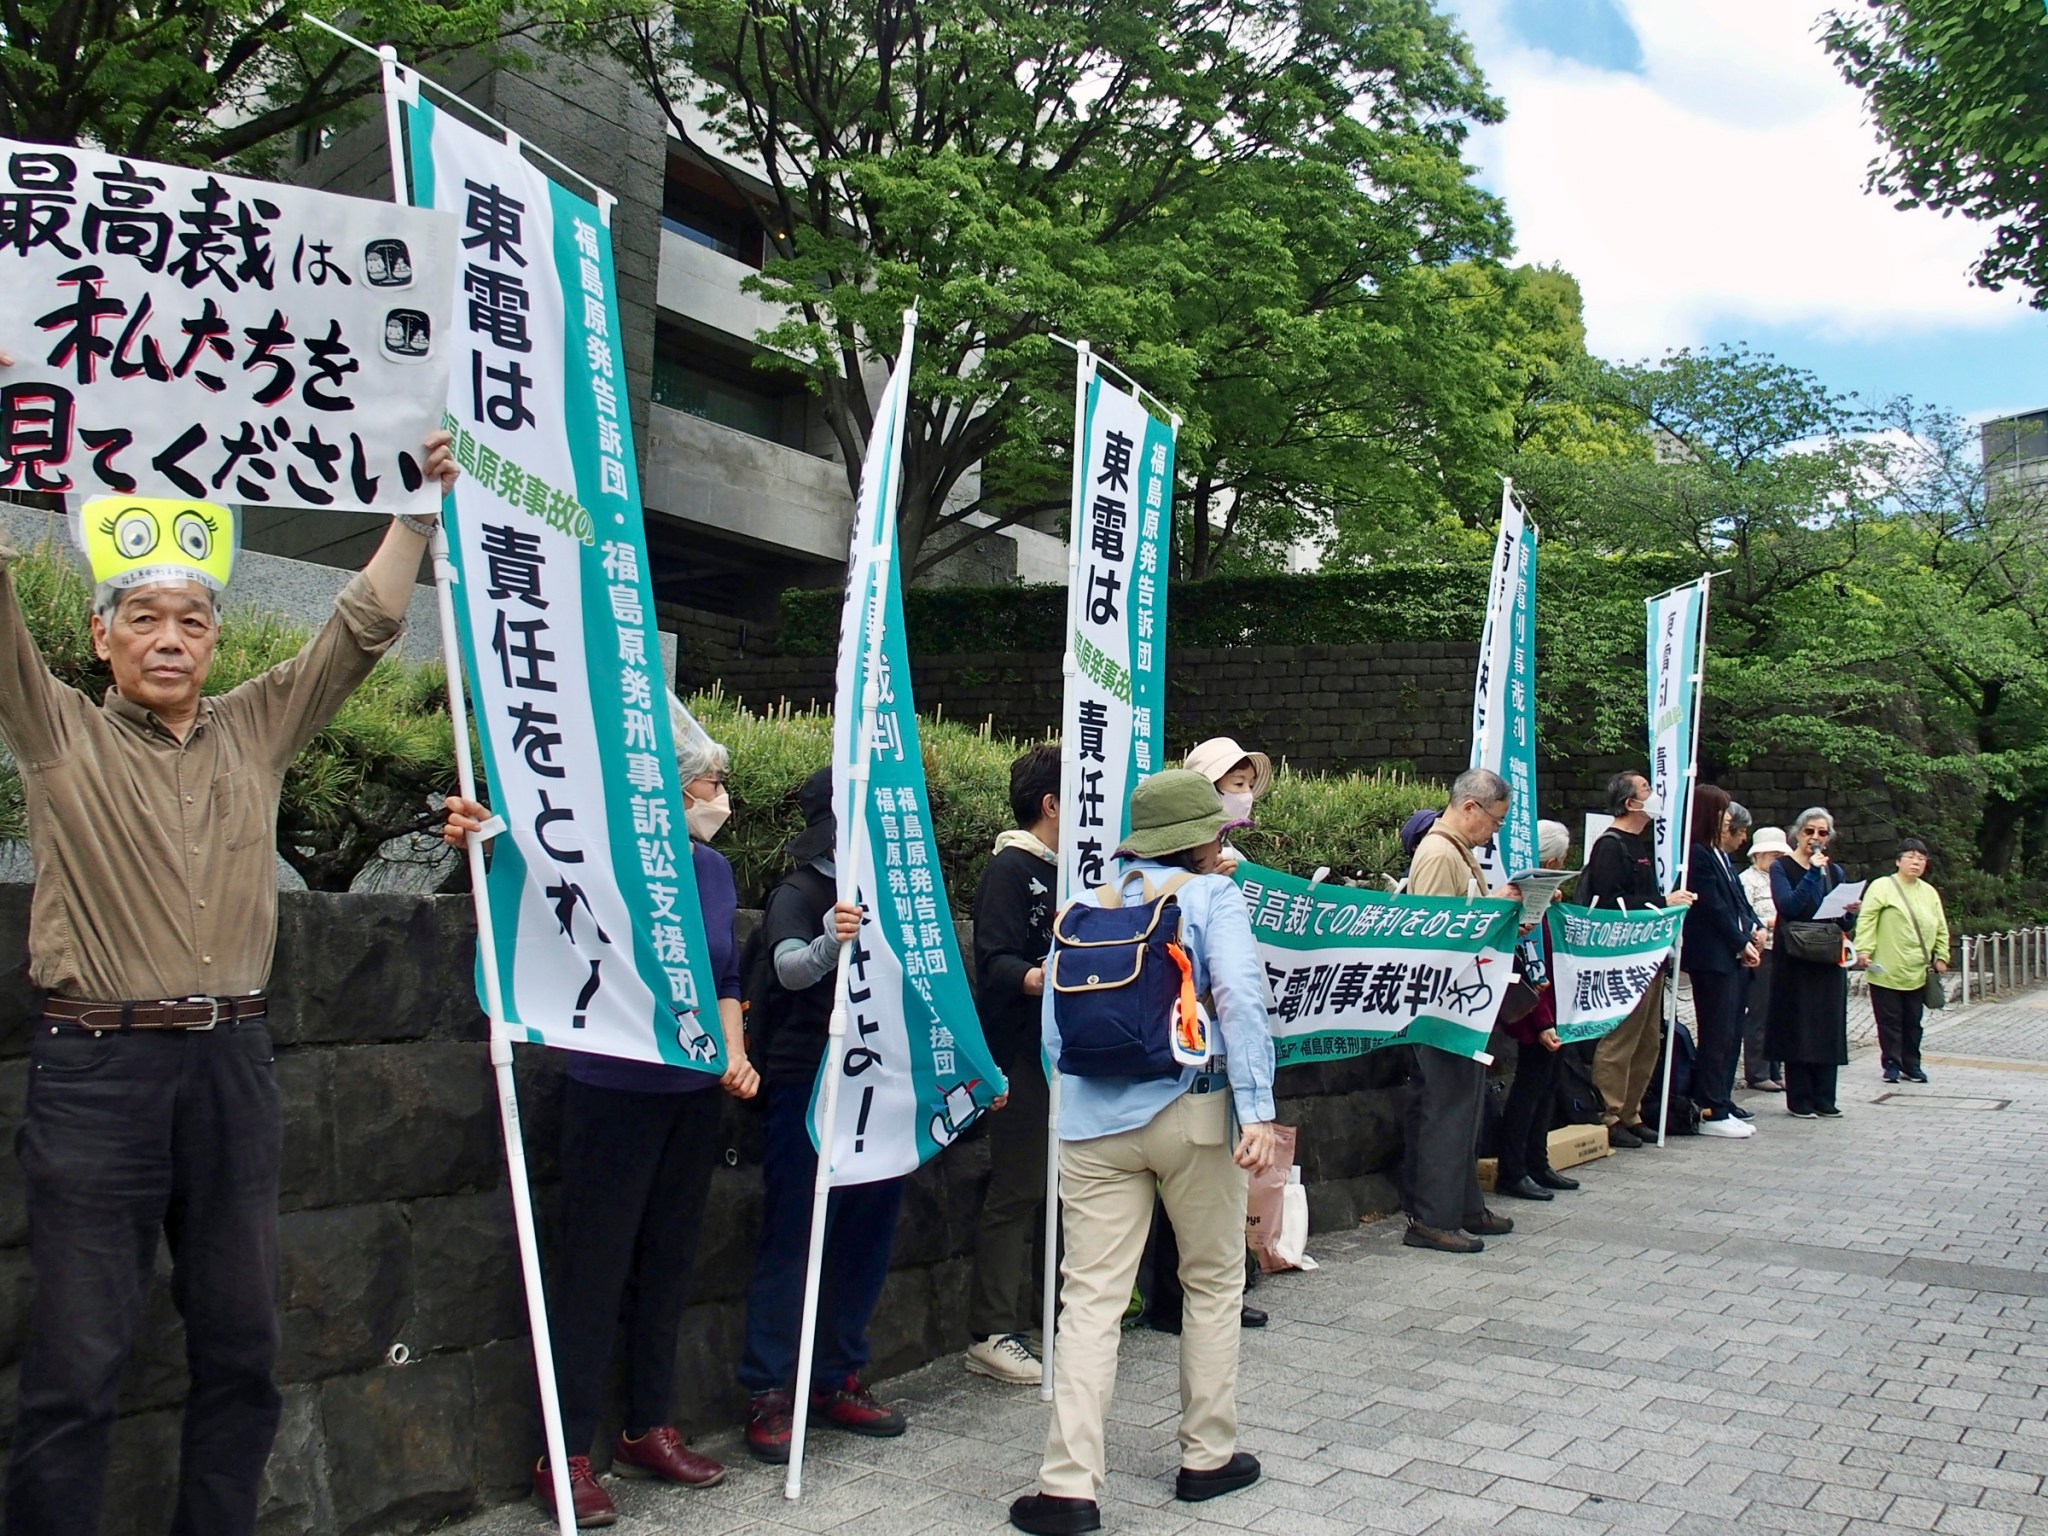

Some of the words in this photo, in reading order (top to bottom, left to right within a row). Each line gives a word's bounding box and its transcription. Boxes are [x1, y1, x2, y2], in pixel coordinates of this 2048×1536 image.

[0, 152, 352, 293] 最高裁は
[461, 178, 537, 432] 東電は
[34, 264, 360, 411] 私たちを
[0, 382, 424, 505] 見てください
[1086, 429, 1134, 626] 東電は
[480, 522, 612, 1030] 責任をとれ！
[1077, 700, 1109, 889] 責任を
[896, 787, 948, 976] 福島原発告訴団
[1240, 878, 1502, 941] 最高裁での勝利をめざす
